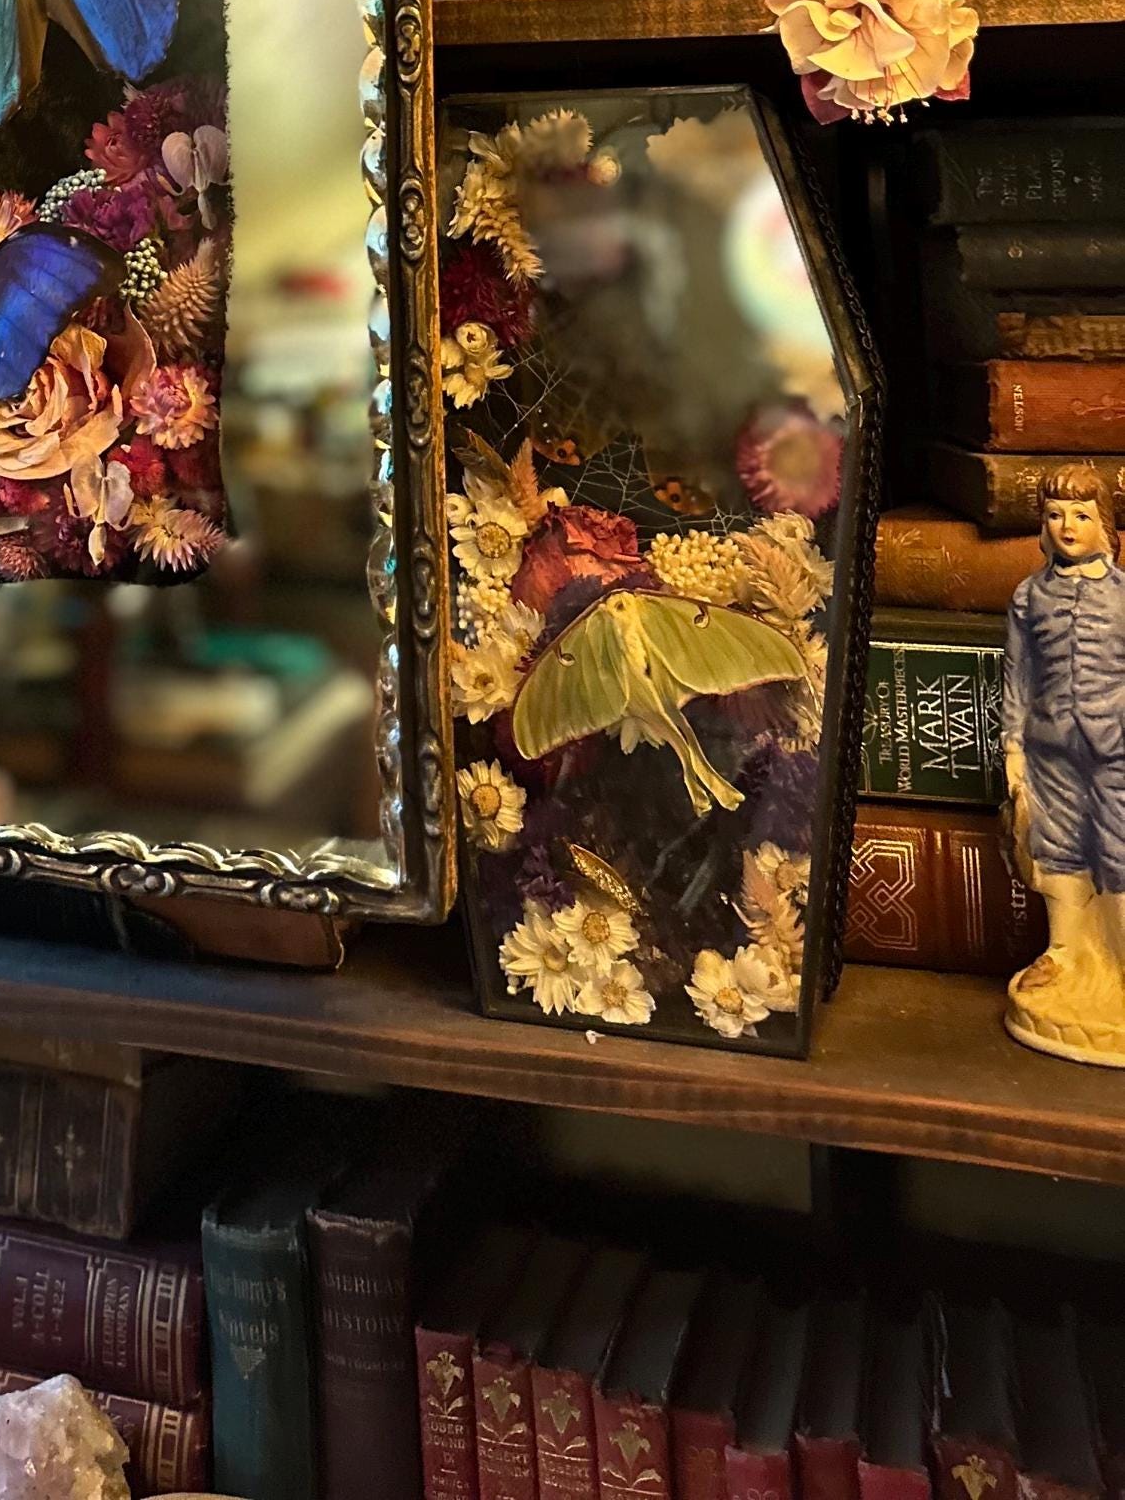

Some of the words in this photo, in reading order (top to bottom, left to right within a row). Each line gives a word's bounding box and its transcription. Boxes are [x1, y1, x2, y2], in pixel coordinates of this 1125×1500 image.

[1012, 383, 1024, 432] NELSON
[893, 643, 910, 743] MASTERPIECES
[878, 701, 893, 765] TREASURY
[915, 675, 950, 772] MARK
[946, 674, 981, 779] TWAIN
[897, 746, 912, 793] WORLD
[323, 1269, 406, 1298] AMERICAN
[322, 1304, 405, 1337] HISTORY
